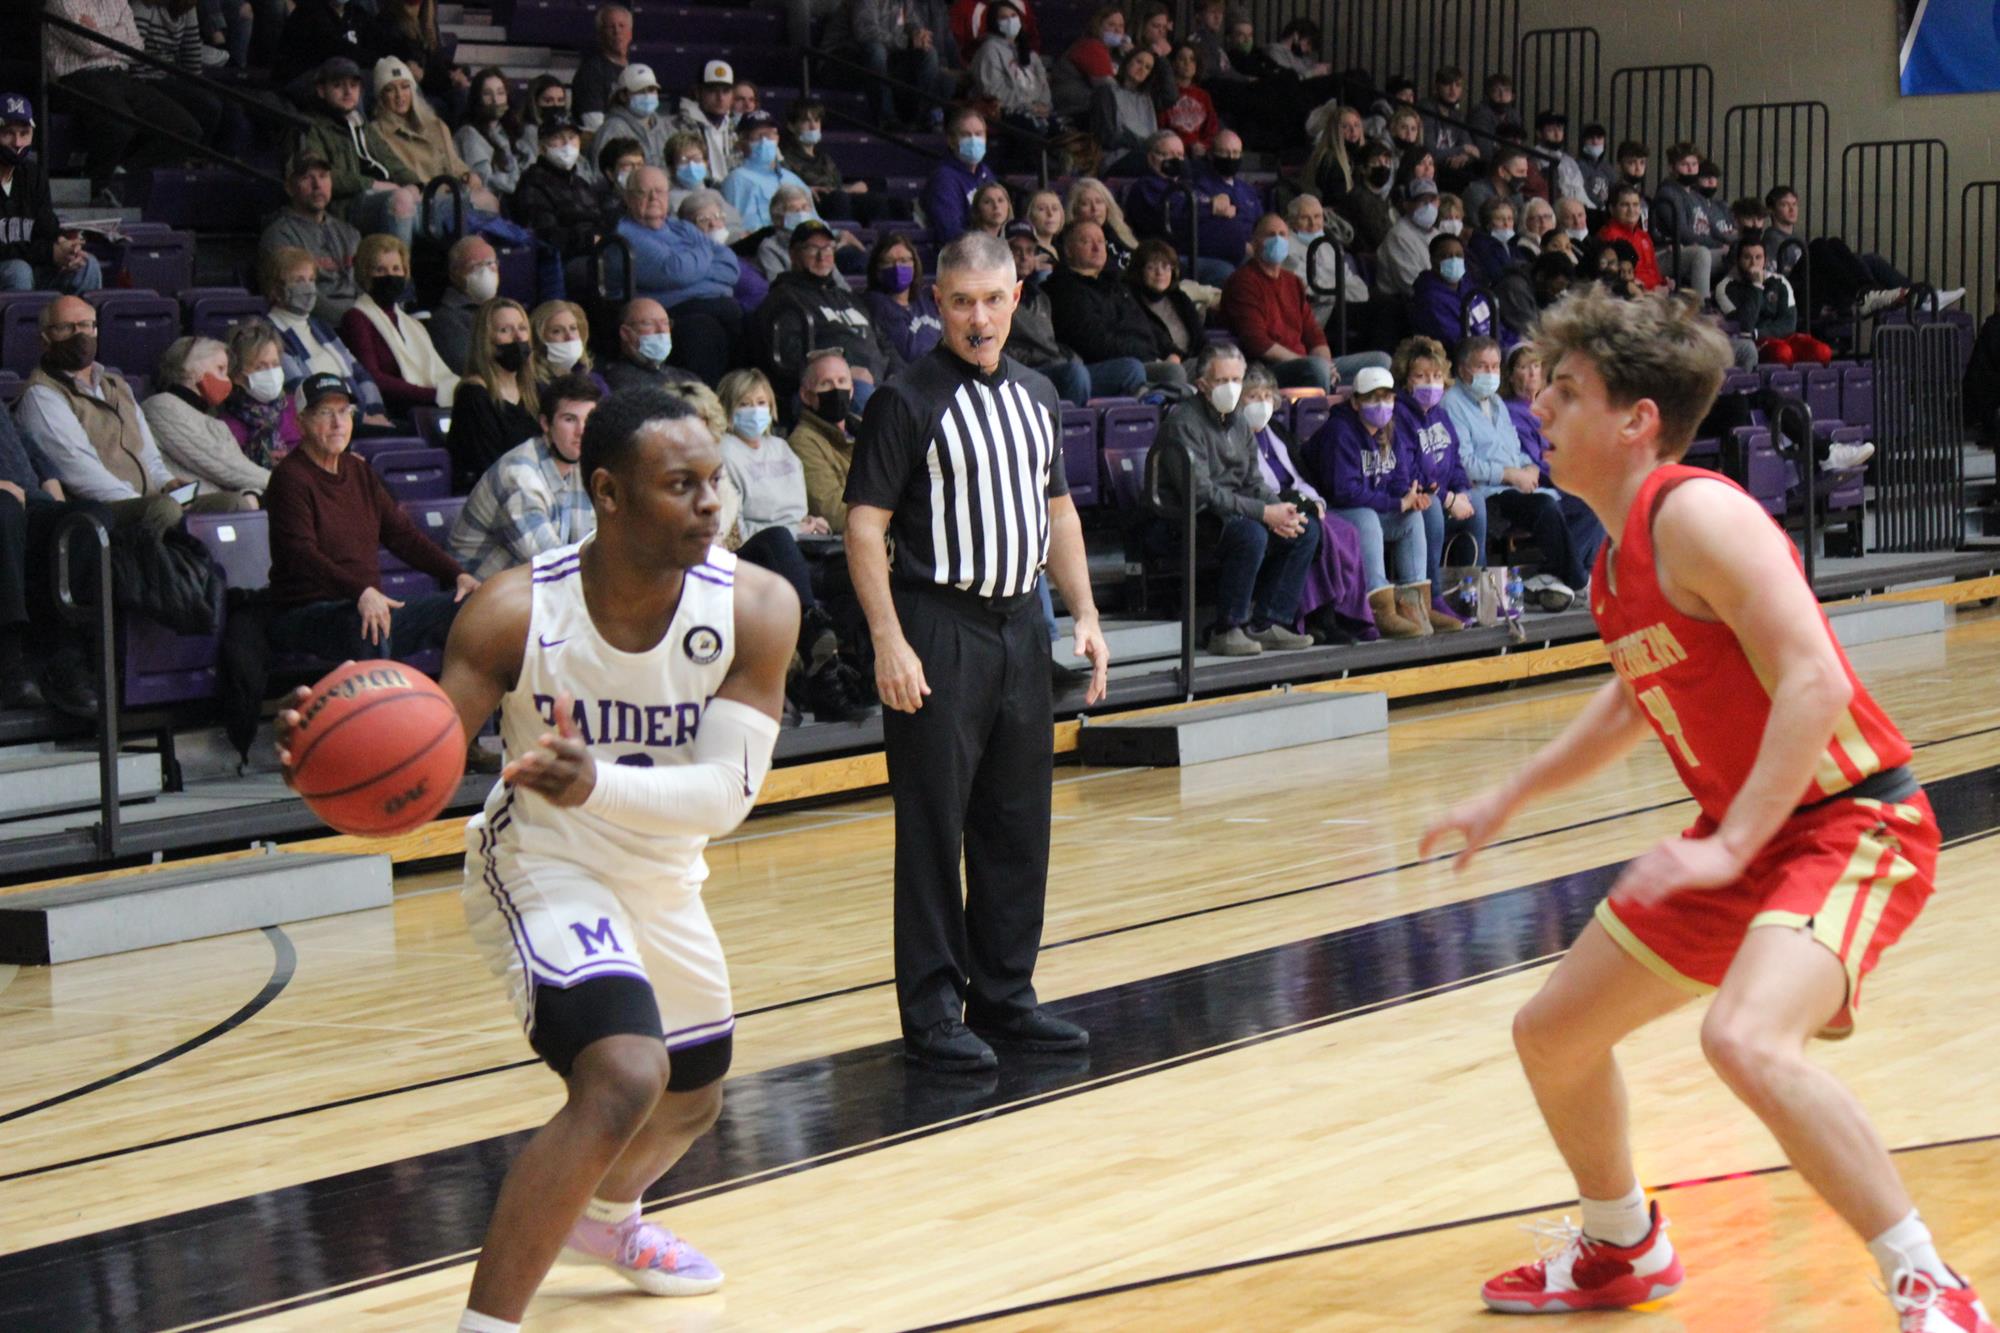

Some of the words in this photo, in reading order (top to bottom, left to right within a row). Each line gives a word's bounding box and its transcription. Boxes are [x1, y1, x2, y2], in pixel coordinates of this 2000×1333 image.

[6, 97, 25, 114] M
[533, 694, 714, 747] RAIDER
[568, 918, 624, 956] M
